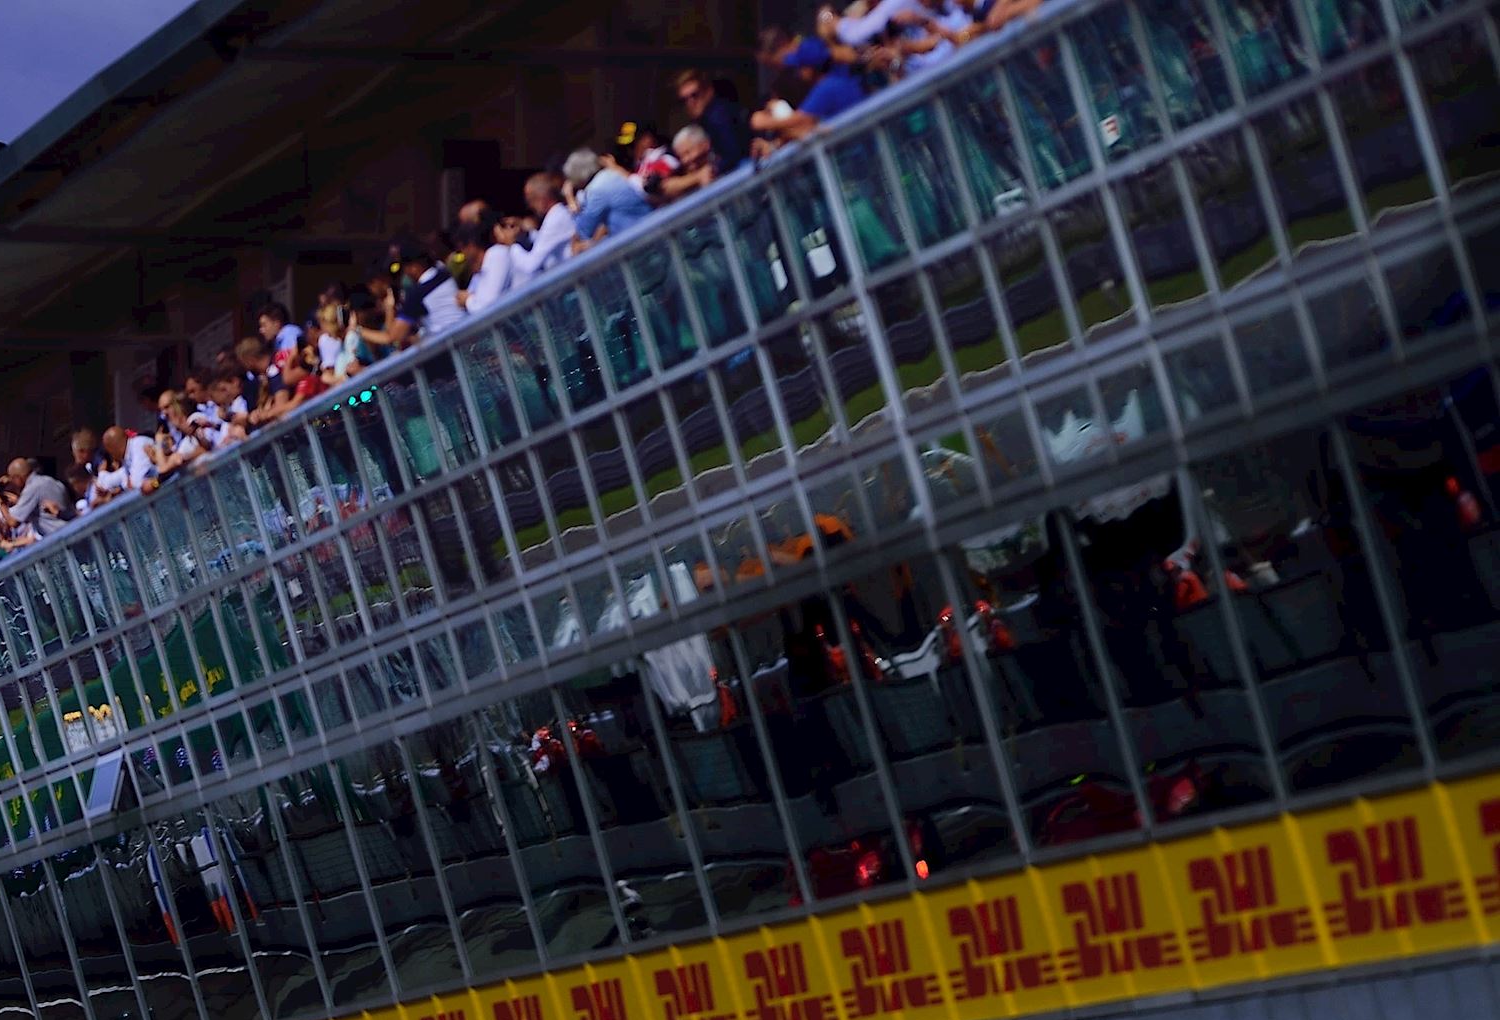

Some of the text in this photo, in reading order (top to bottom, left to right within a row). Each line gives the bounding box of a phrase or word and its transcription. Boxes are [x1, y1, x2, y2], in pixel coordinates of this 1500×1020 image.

[1062, 875, 1166, 981] DHL
[1186, 848, 1303, 960] DHL
[1324, 820, 1455, 935] DHL
[841, 922, 928, 1018] DHL
[949, 899, 1044, 1000] DHL
